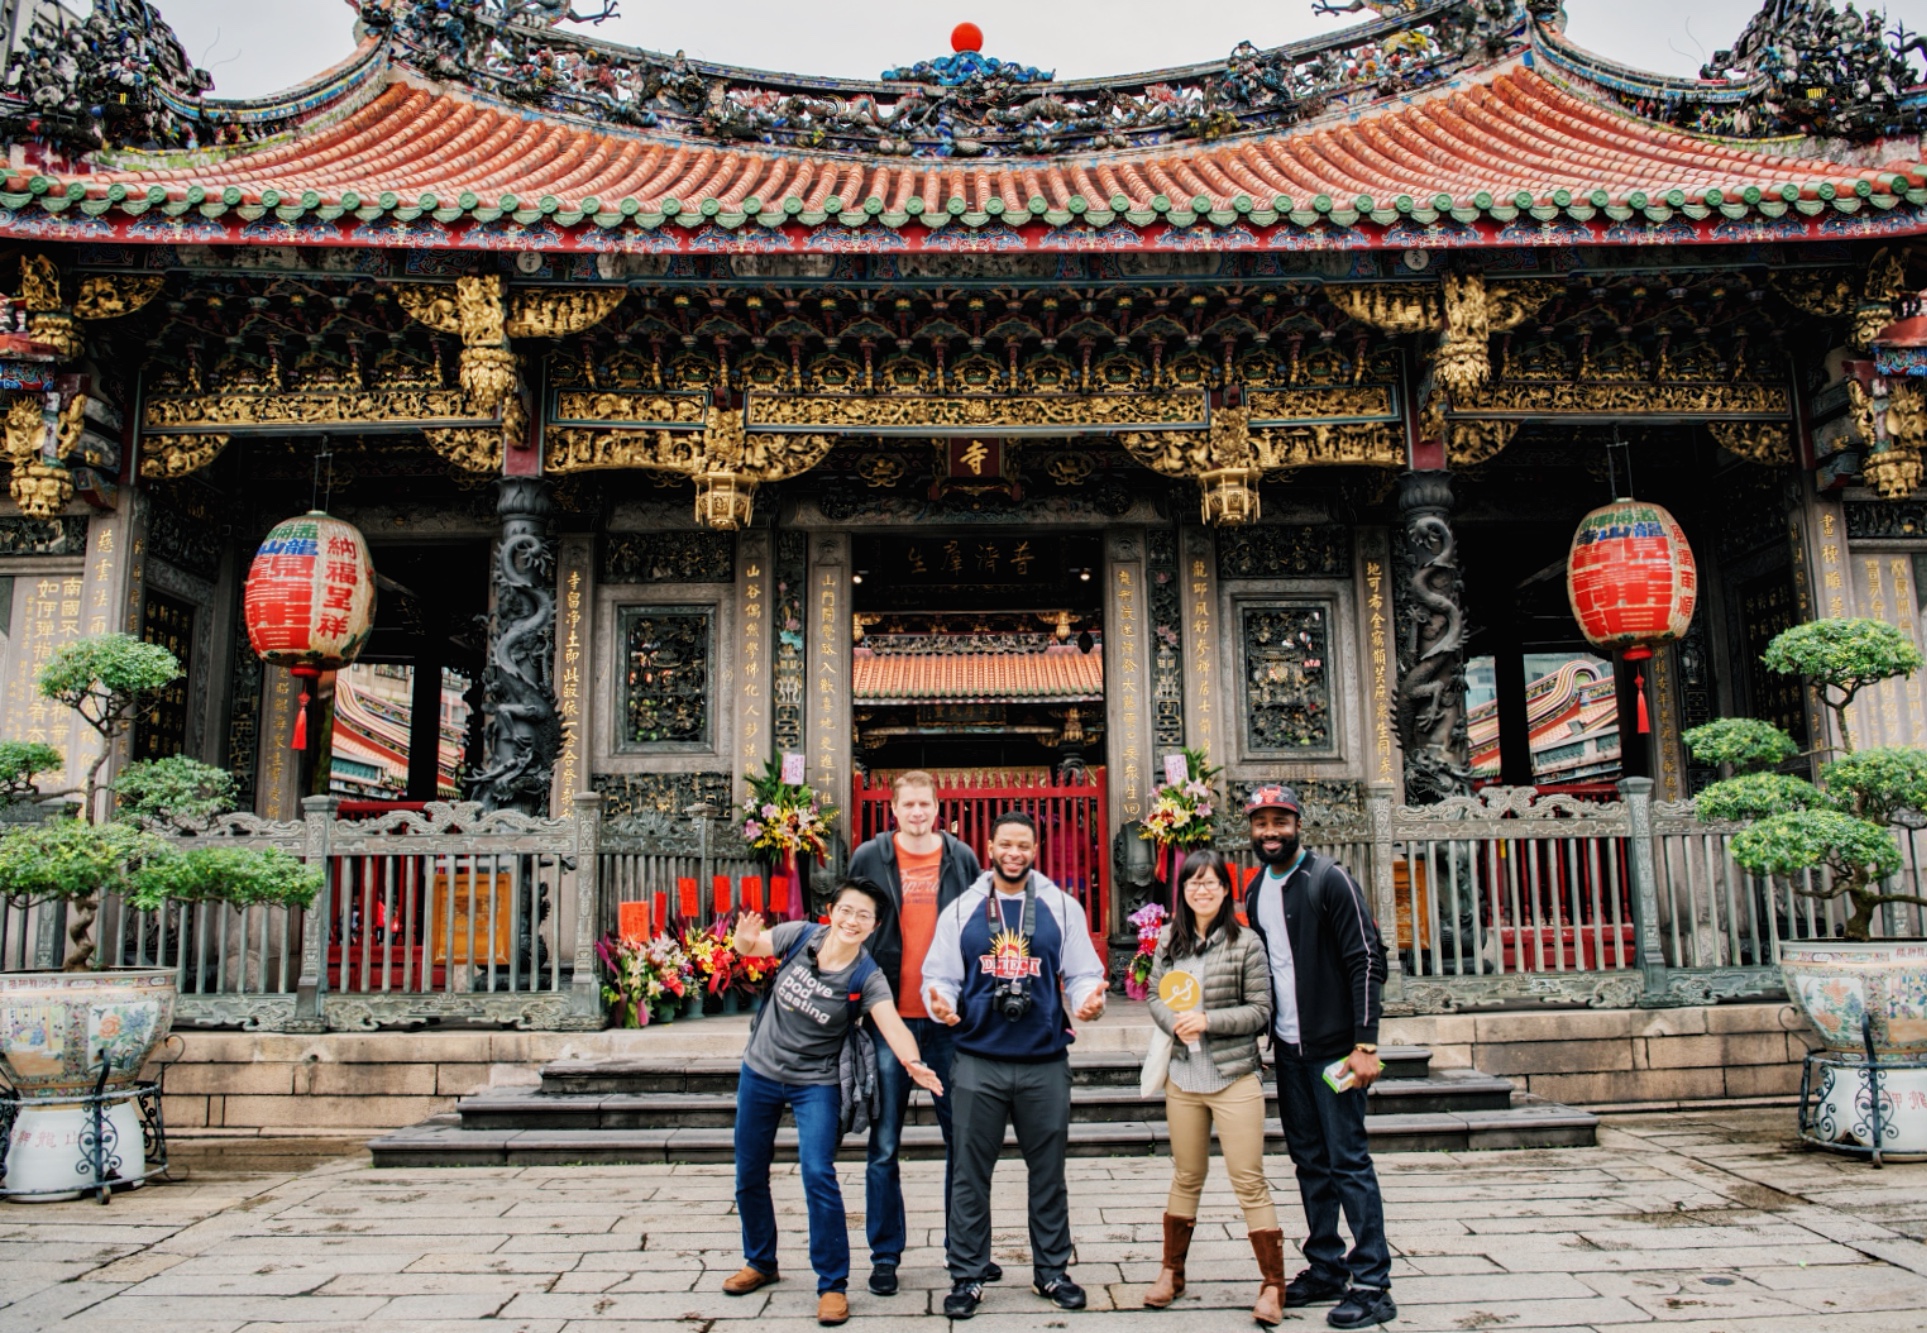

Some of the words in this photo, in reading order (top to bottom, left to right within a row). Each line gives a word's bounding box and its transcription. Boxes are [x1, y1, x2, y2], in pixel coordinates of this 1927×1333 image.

[959, 439, 989, 476] 寺
[316, 536, 359, 641] 納福呈祥
[778, 986, 831, 1025] casting
[781, 975, 814, 999] pod
